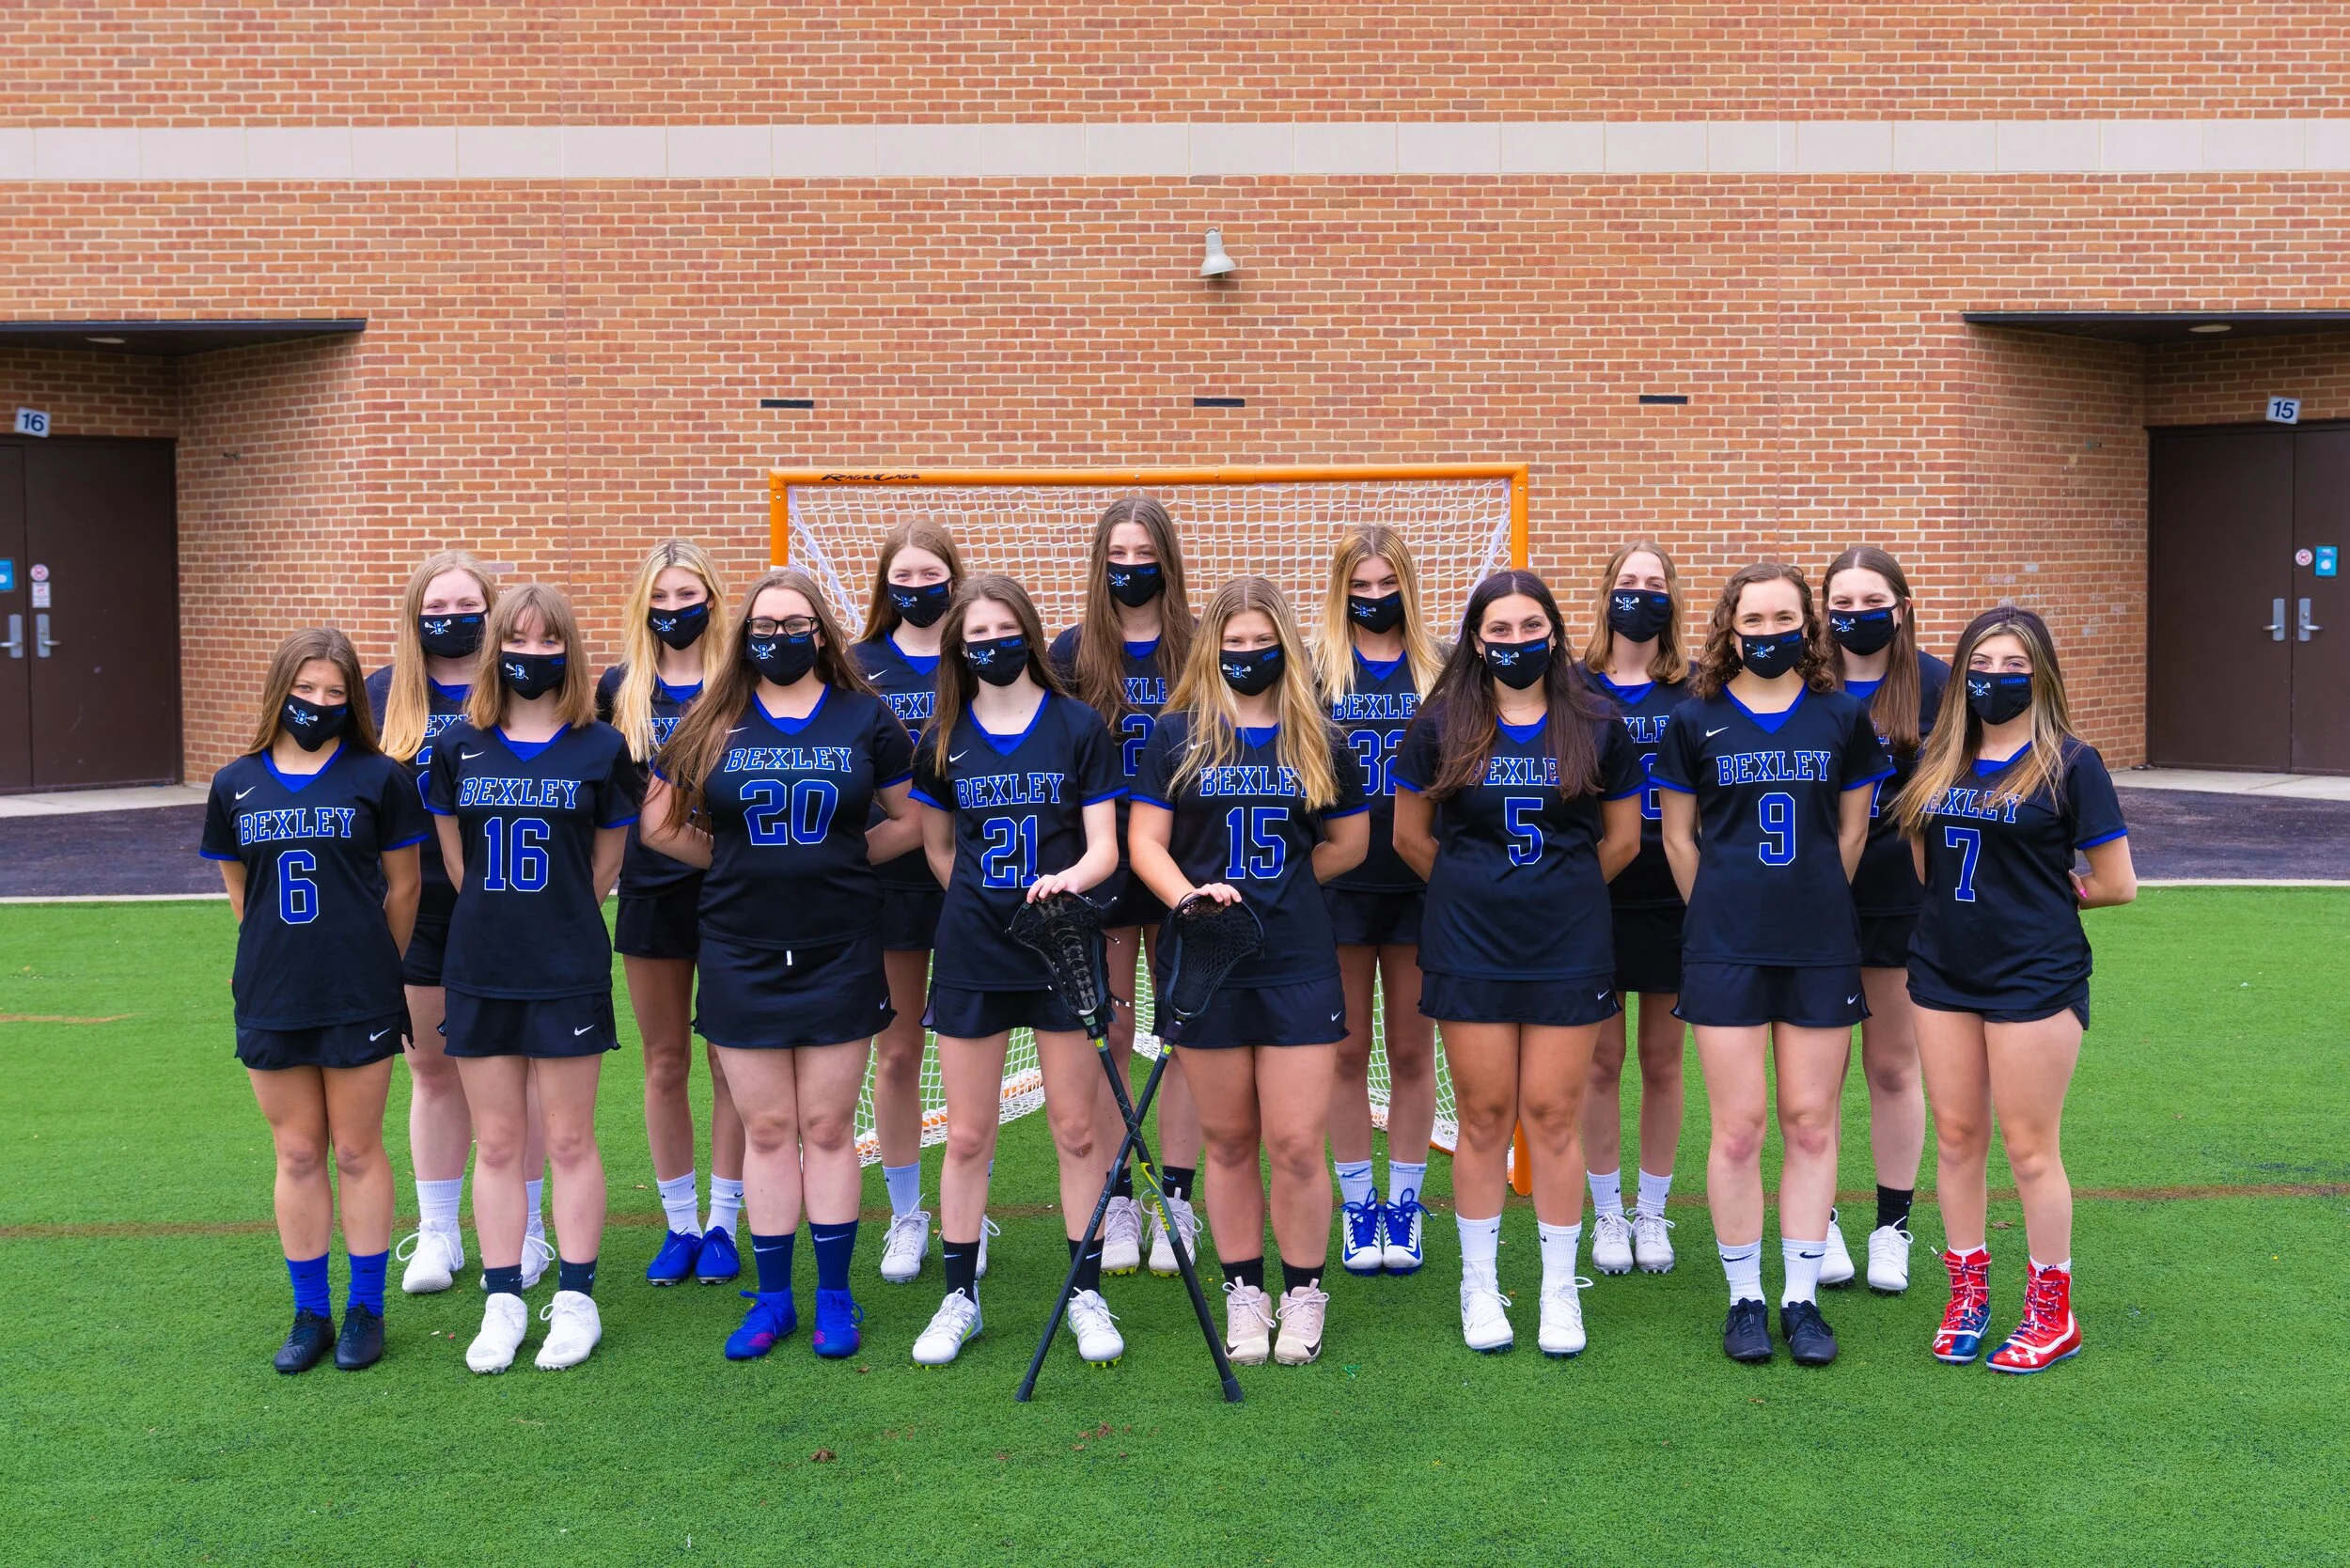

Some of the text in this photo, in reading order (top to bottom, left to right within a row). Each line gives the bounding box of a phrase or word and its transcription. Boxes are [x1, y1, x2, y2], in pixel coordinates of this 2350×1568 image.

[22, 413, 45, 432] 16
[2273, 400, 2295, 419] 15
[295, 710, 308, 724] B
[1332, 693, 1422, 721] BEXLE
[724, 747, 852, 773] BEXLEY
[1716, 750, 1830, 786] BEXLEY
[459, 777, 582, 809] BEXLEY
[955, 773, 1065, 808] BEXLEY
[240, 808, 355, 845] BEXLEY
[739, 778, 838, 846] 20
[1758, 792, 1796, 867] 9
[1226, 807, 1289, 880] 15
[1504, 796, 1543, 868] 5
[484, 816, 551, 893] 16
[980, 814, 1040, 889] 21
[1944, 825, 1982, 902] 7
[276, 849, 320, 925] 6
